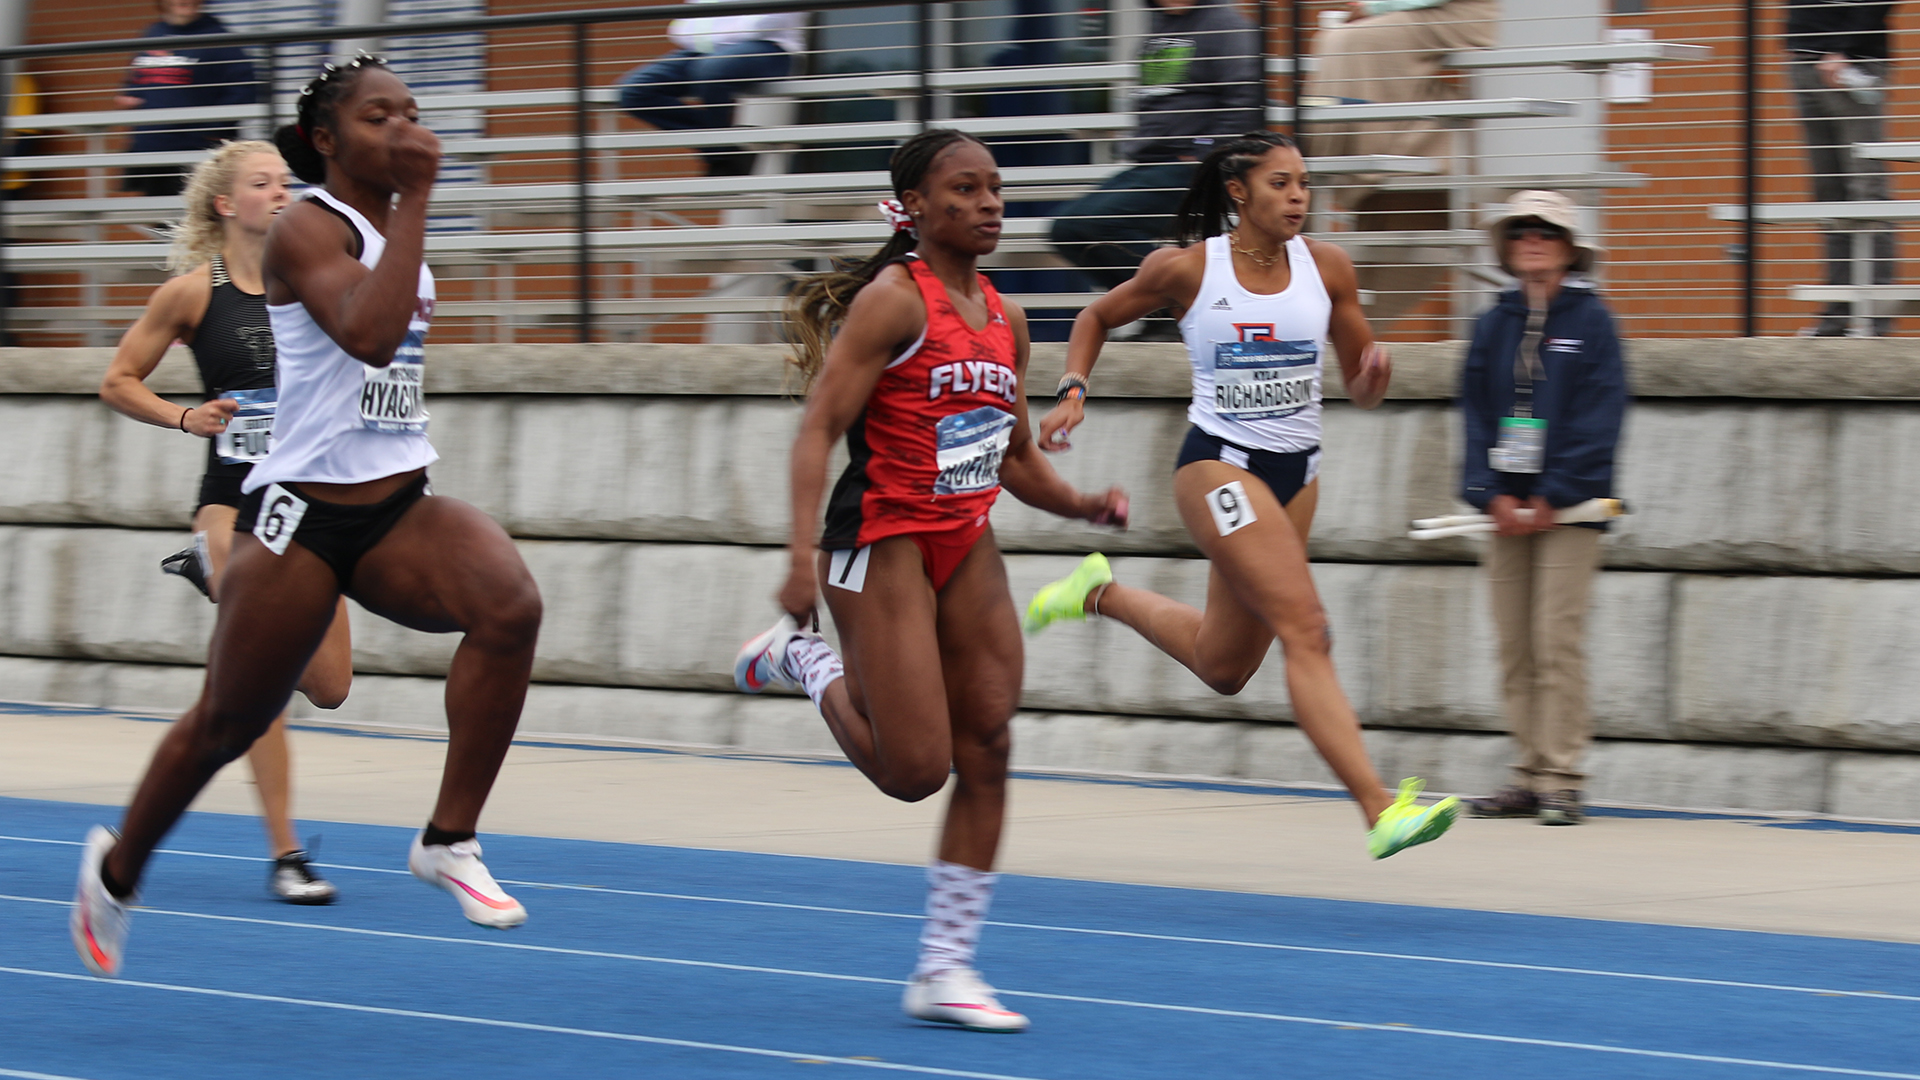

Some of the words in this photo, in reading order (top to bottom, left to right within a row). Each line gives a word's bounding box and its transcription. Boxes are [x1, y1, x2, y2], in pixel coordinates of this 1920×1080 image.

[1216, 378, 1313, 409] RICHARDSON
[1253, 370, 1279, 381] KYLA
[264, 495, 294, 542] 6
[1217, 487, 1242, 528] 9
